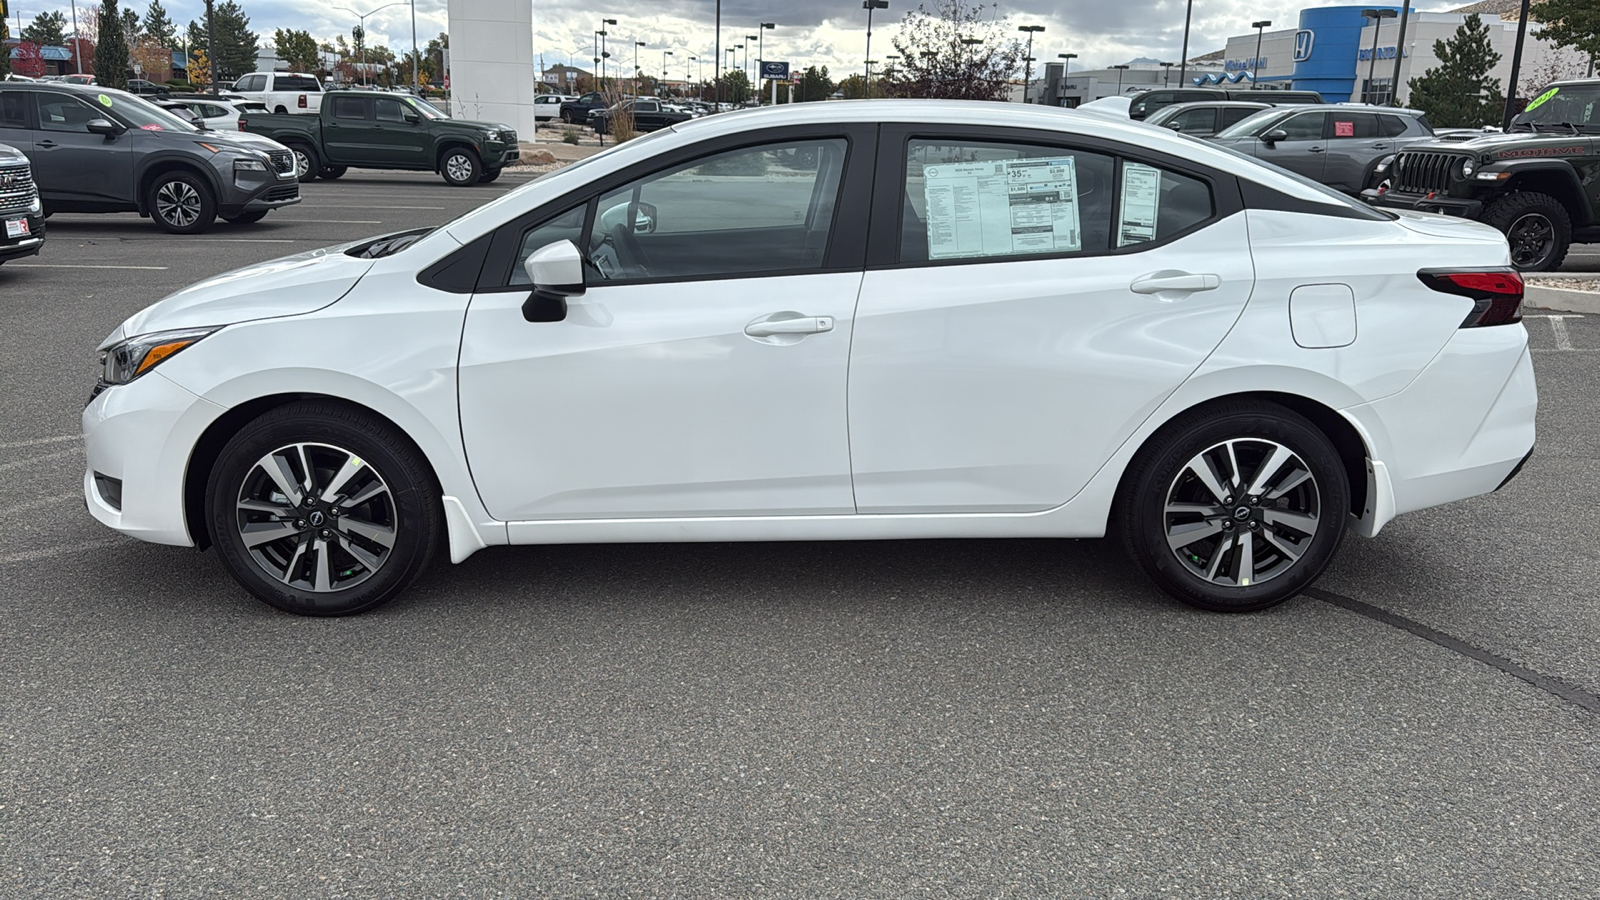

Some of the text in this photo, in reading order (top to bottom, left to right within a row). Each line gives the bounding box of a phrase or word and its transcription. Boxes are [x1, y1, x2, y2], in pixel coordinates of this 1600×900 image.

[1359, 46, 1409, 61] HNDA
[1531, 90, 1553, 109] 2021
[1497, 147, 1585, 158] MOJAVE
[1011, 170, 1022, 178] 35
